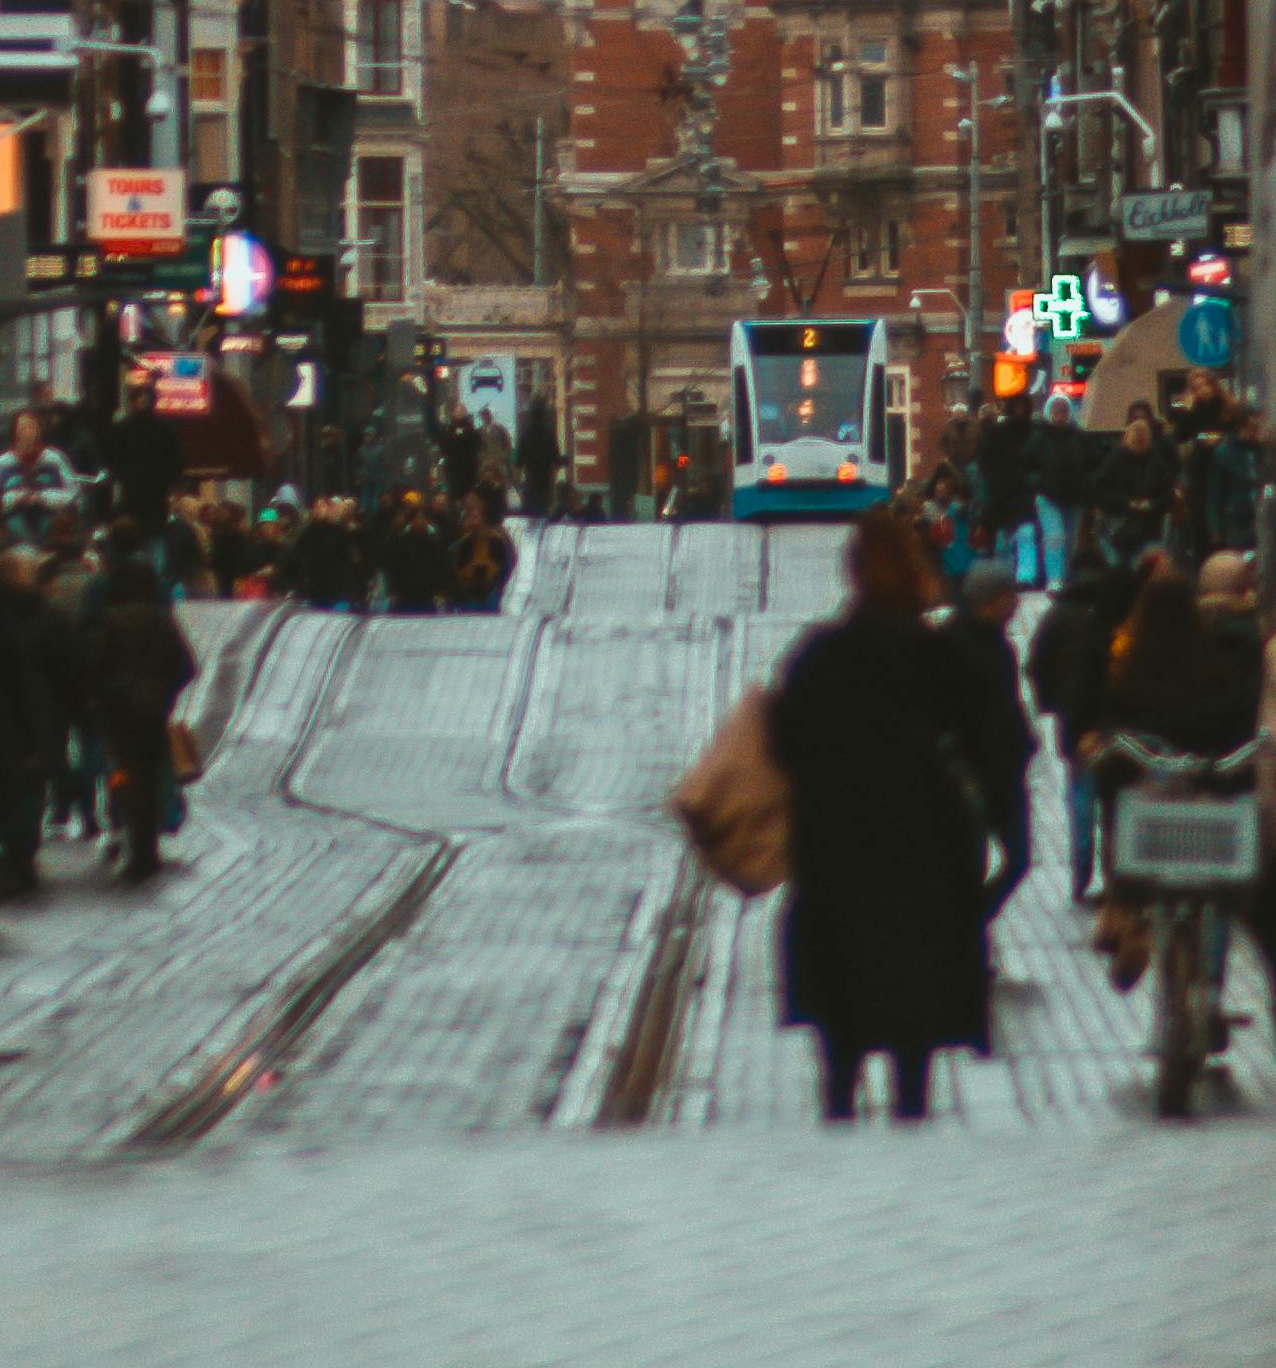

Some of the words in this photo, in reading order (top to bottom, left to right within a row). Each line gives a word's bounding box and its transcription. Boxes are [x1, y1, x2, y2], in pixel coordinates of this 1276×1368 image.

[107, 179, 165, 194] TOURS
[101, 213, 172, 228] TICKETS
[803, 328, 815, 348] 2
